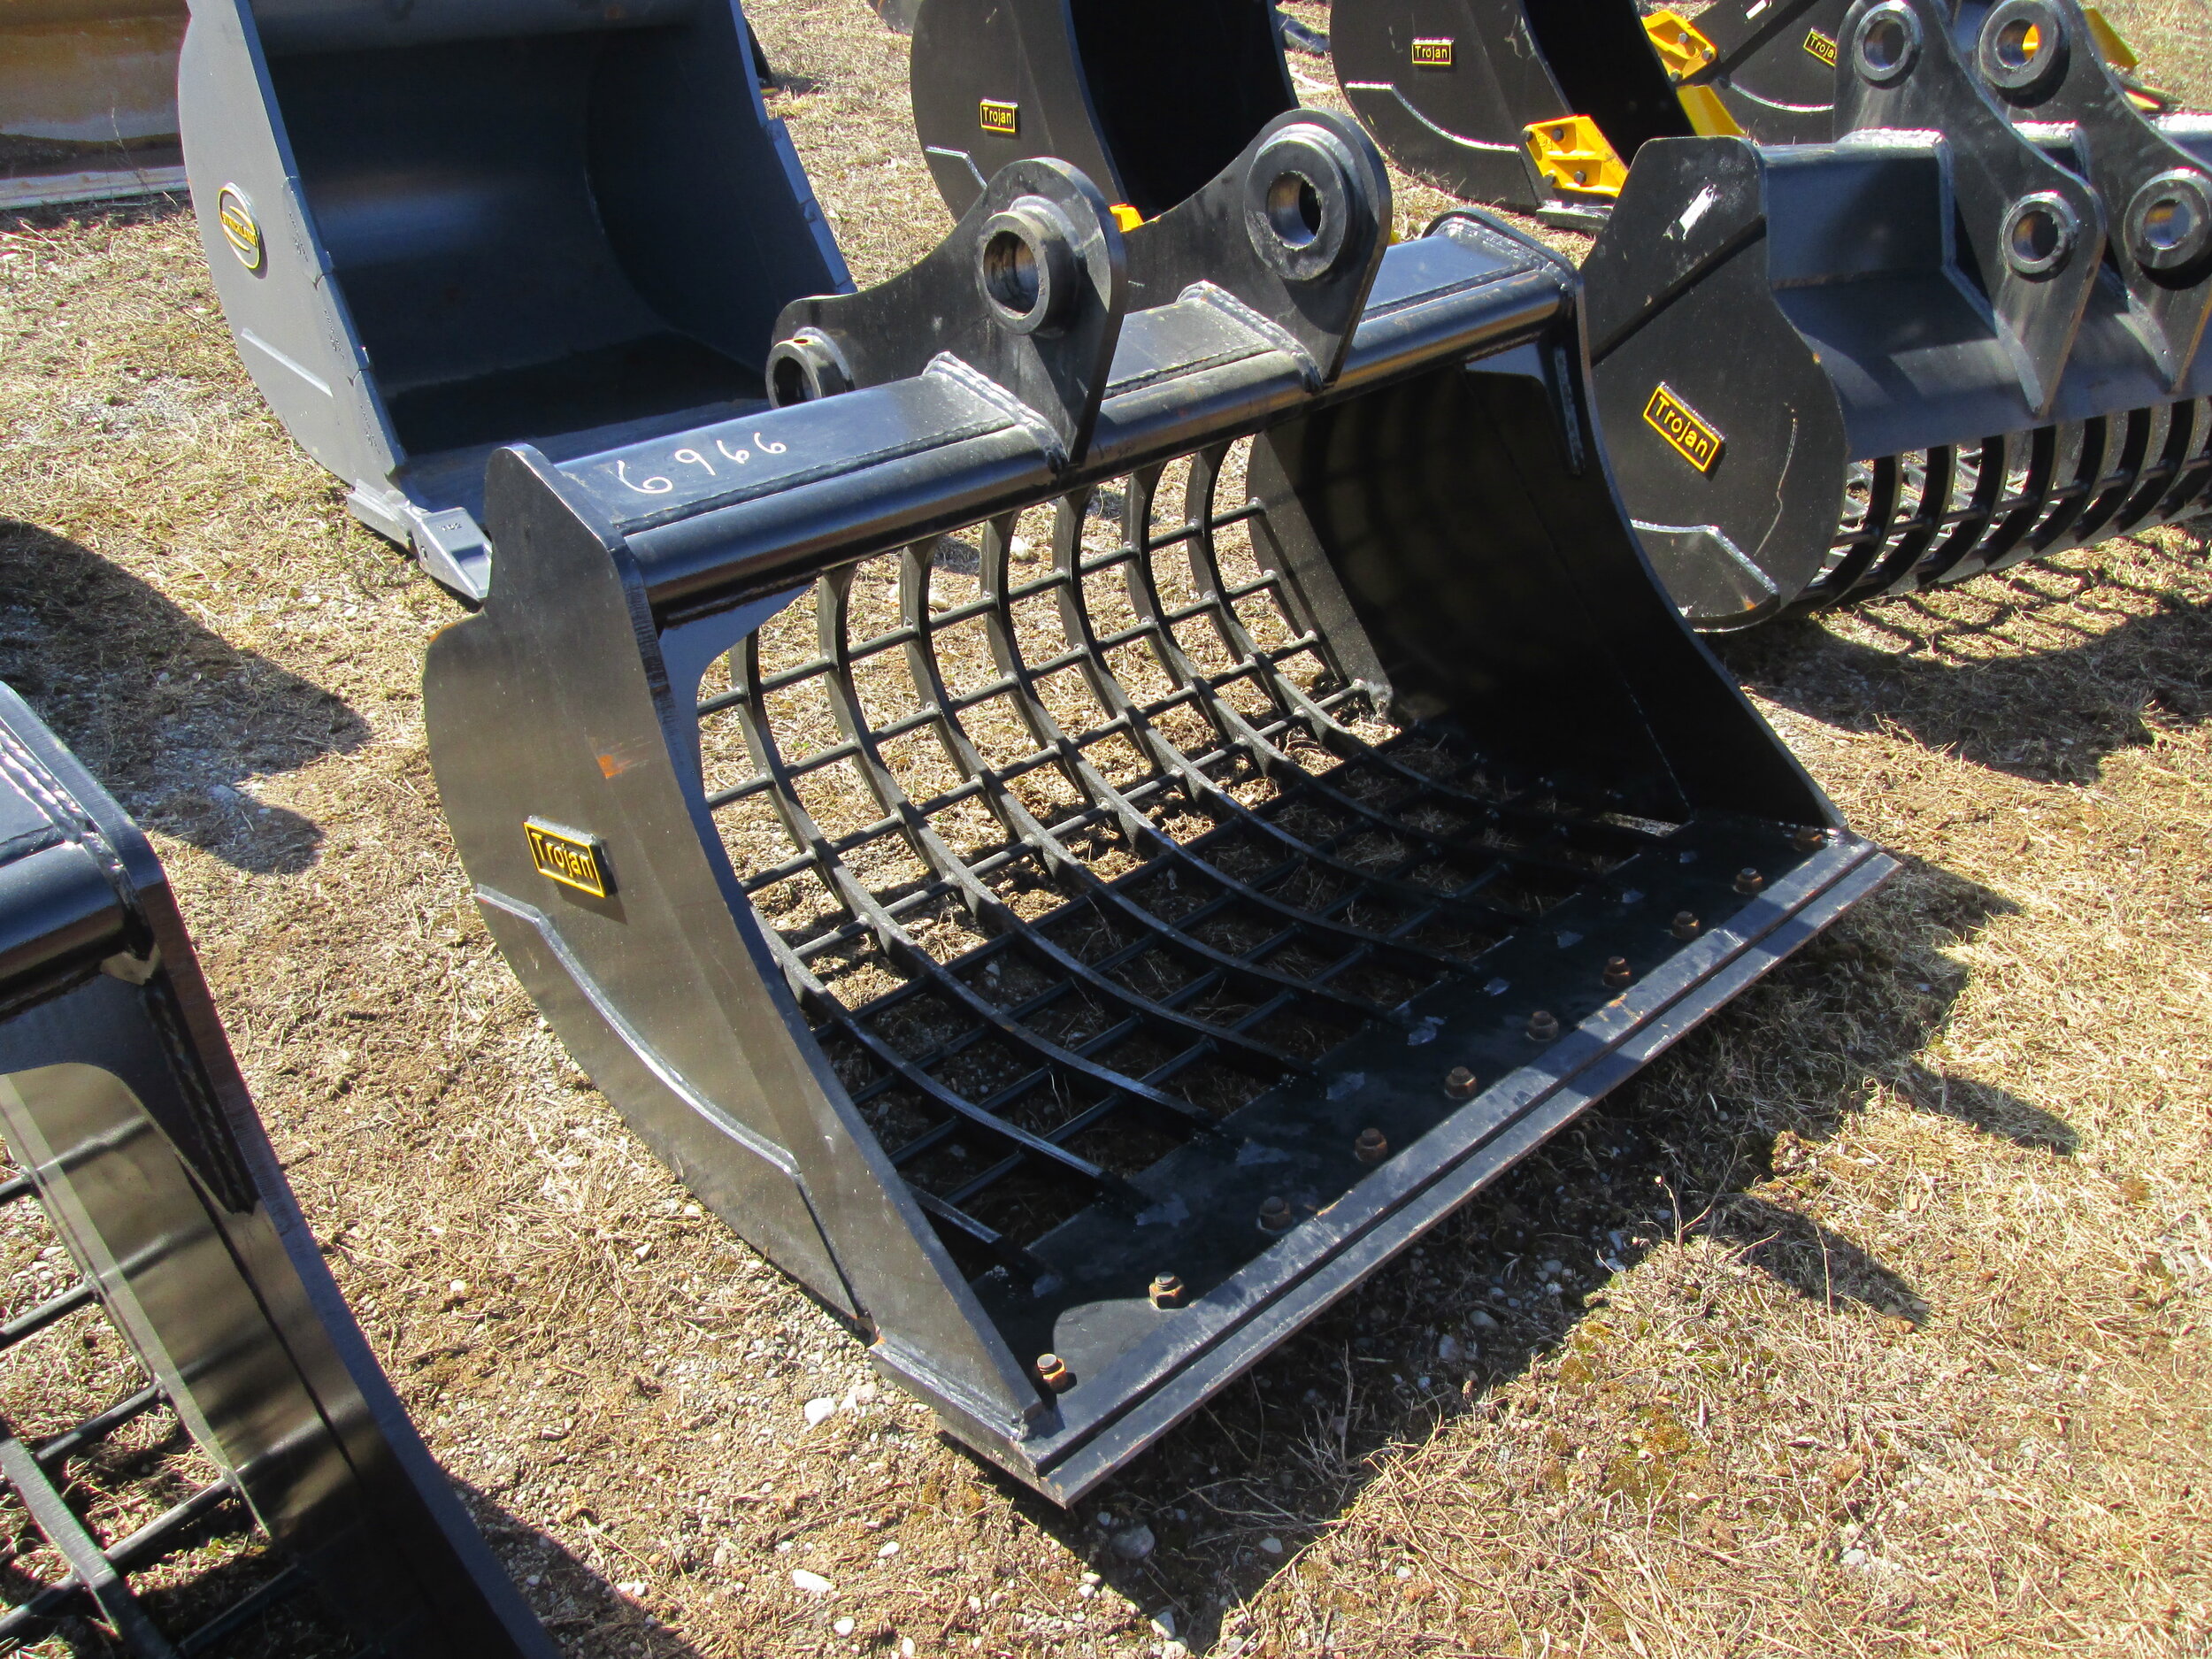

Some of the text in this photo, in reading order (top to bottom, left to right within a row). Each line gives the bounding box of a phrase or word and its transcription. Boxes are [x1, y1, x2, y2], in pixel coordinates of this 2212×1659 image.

[1415, 45, 1448, 61] Trojan
[982, 106, 1012, 127] Trojan
[1655, 395, 1709, 457] Trojan
[530, 832, 594, 879] Trojan
